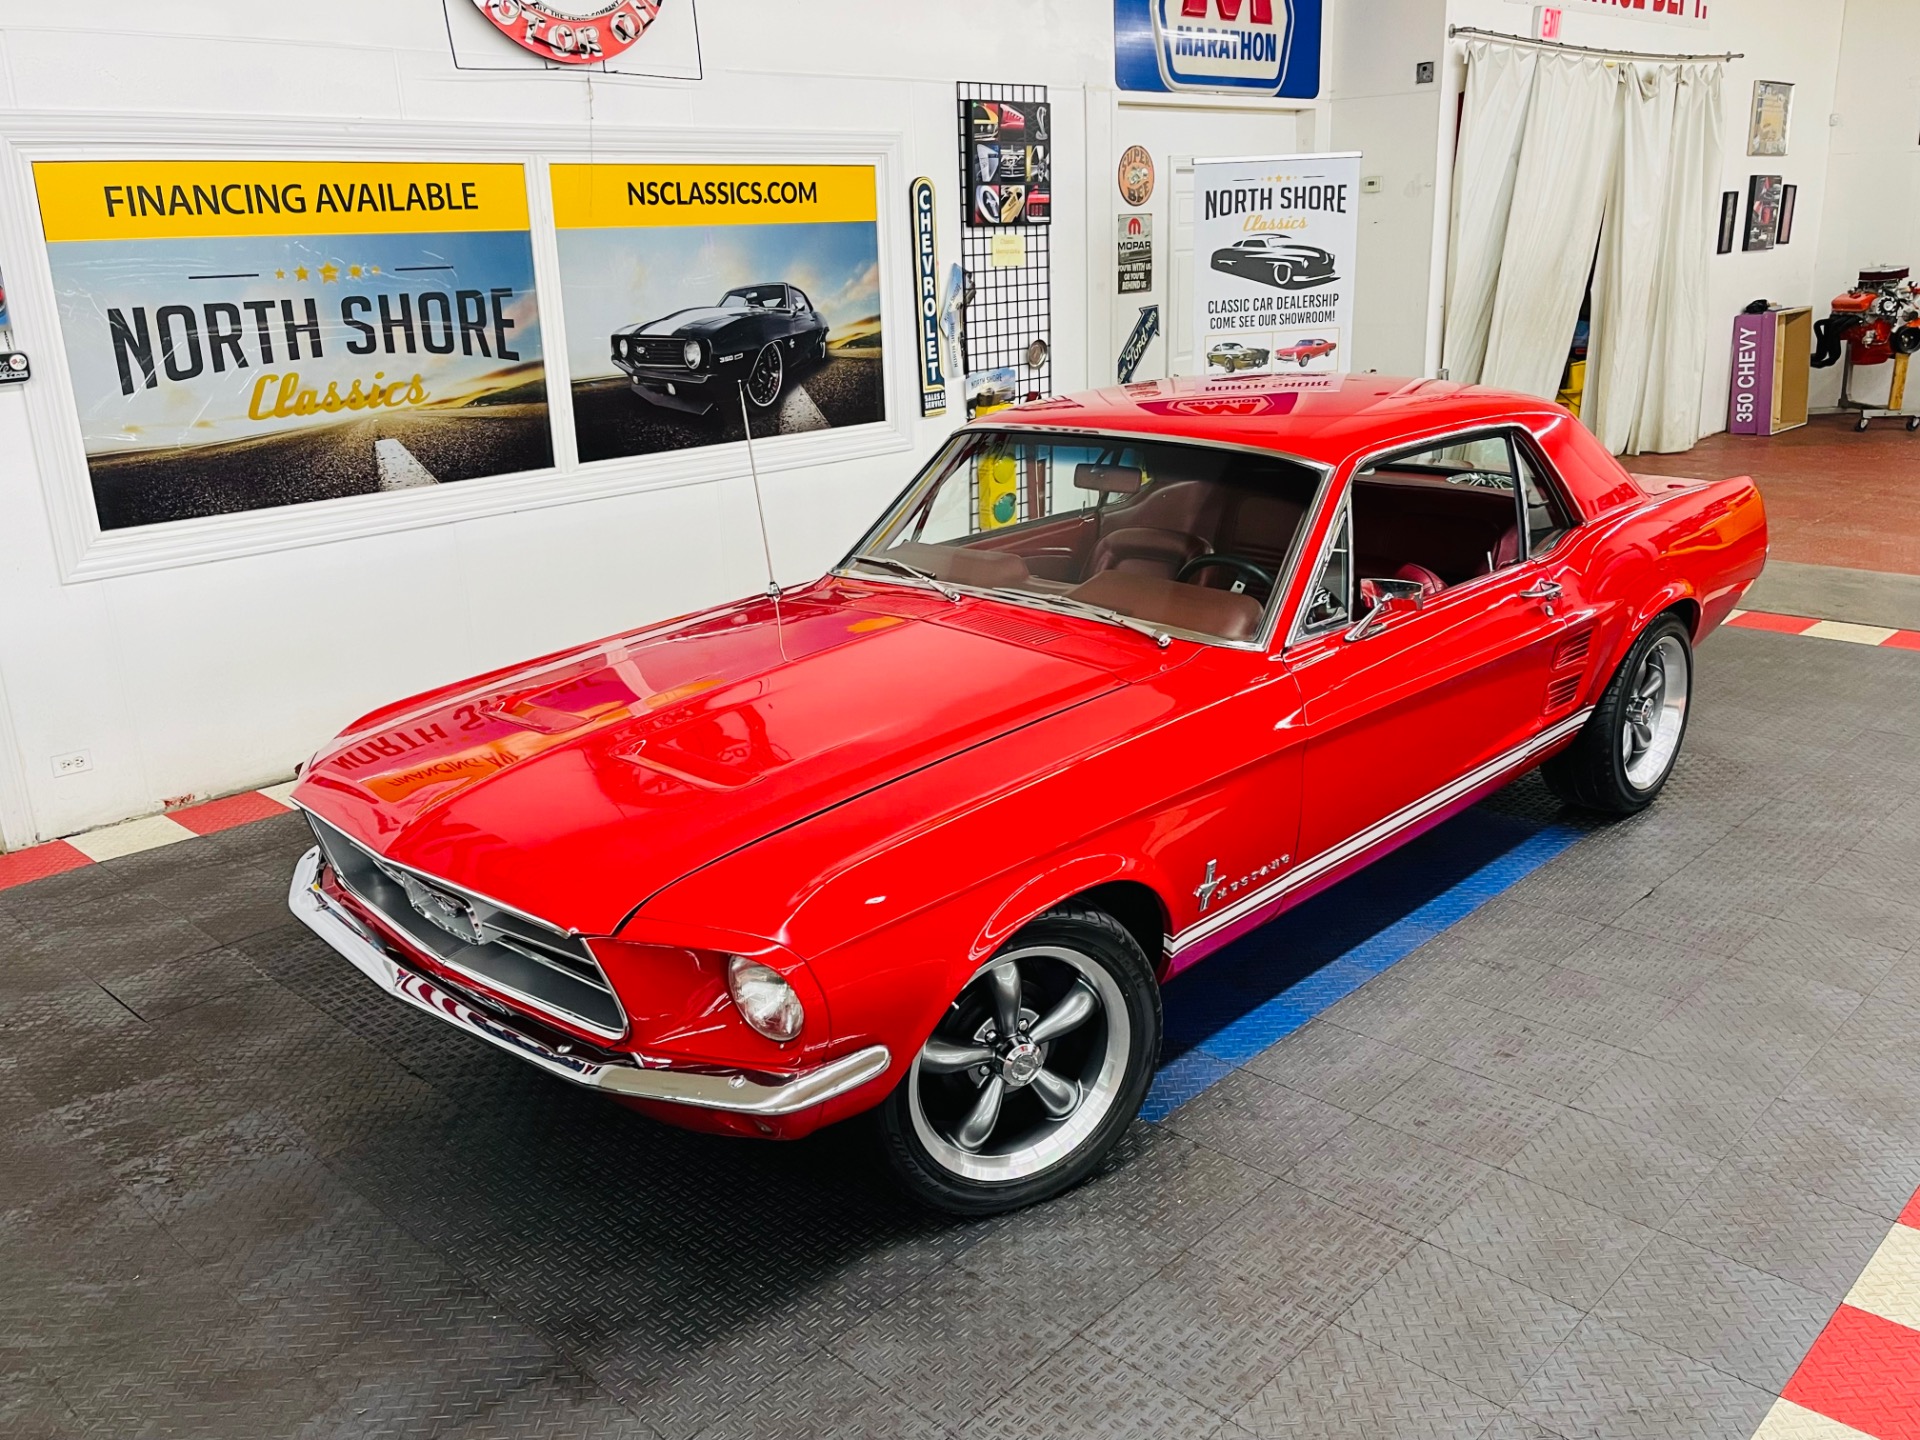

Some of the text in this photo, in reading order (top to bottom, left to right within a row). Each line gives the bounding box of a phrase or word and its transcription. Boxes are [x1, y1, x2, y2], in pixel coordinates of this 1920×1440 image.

[473, 0, 603, 60] OTOR
[1175, 25, 1277, 62] MARATHON
[1122, 148, 1151, 180] SUPER
[103, 182, 479, 218] FINANCING AVAILABLE
[626, 181, 818, 206] NSCLASSICS.COM
[1127, 180, 1150, 203] BEE
[1205, 184, 1348, 220] NORTH SHORE
[1242, 214, 1309, 232] Classics
[1117, 241, 1151, 251] MOPAR
[918, 189, 939, 381] CHEVROLET
[1207, 293, 1340, 315] CLASSIC CAR DEALERSHIP
[1209, 310, 1336, 330] COME SEE OUR SHOWROOM!
[106, 288, 520, 396] NORTH SHORE
[1125, 327, 1148, 370] Ford
[1736, 327, 1757, 423] 350 CHEVY
[248, 371, 431, 421] Classics
